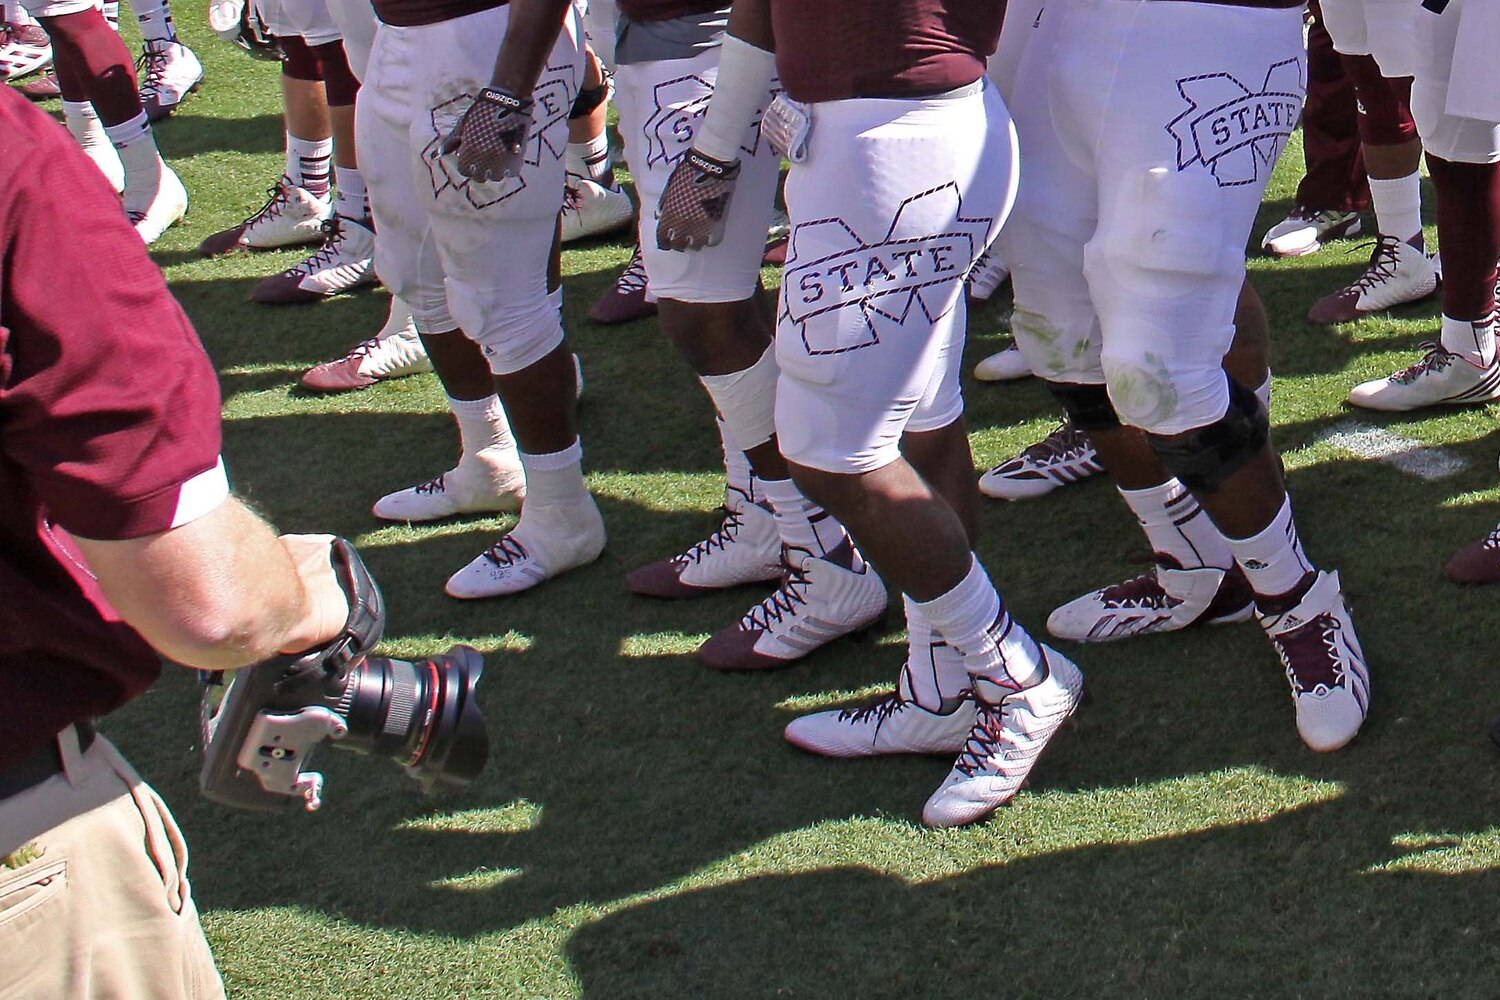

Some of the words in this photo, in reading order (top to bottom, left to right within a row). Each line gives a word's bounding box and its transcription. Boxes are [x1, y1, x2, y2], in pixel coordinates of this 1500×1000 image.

[486, 89, 521, 107] adizero
[1210, 101, 1296, 147] STATE
[690, 154, 724, 175] adizero
[799, 243, 957, 305] STATE
